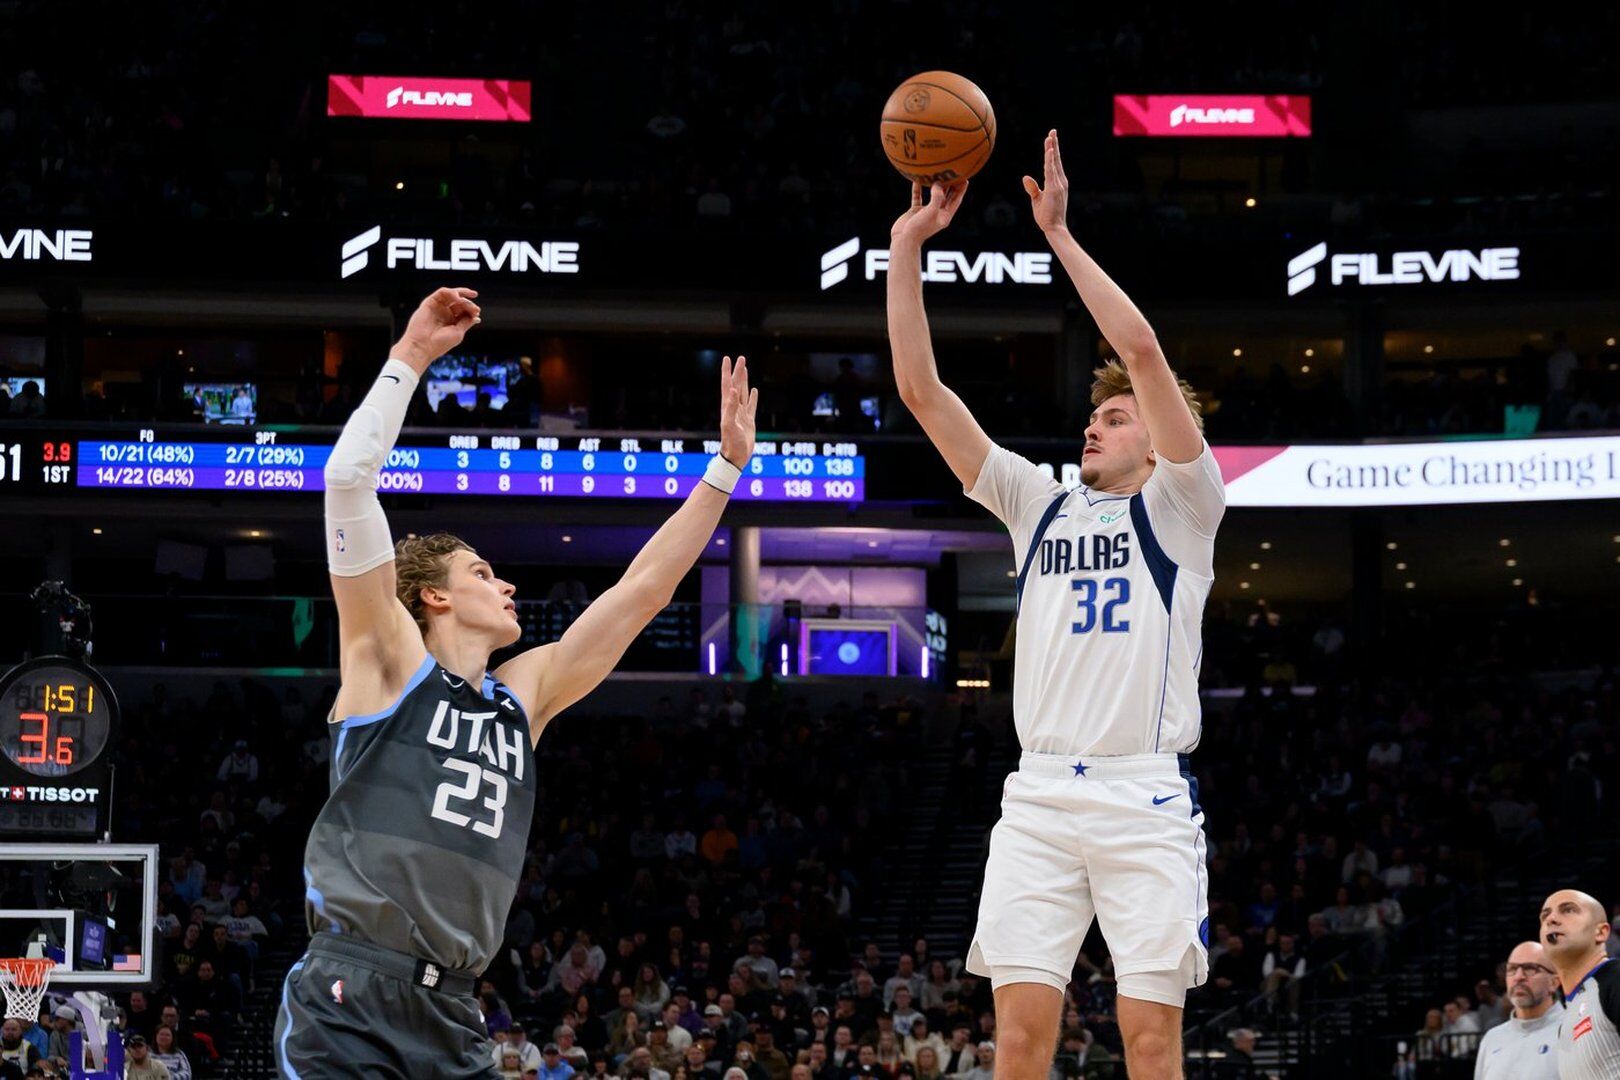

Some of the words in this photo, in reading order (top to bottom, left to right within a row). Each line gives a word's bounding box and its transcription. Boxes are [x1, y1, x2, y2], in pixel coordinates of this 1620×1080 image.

[402, 91, 472, 106] FILEVINE
[1185, 108, 1255, 123] FILEVINE
[387, 238, 579, 273] FILEVINE
[865, 249, 1052, 284] FEVINE
[1331, 247, 1520, 285] FILEVINE
[43, 443, 71, 462] 3.9
[256, 432, 276, 445] 3PT
[579, 438, 600, 452] AST
[620, 439, 641, 452] STL
[661, 440, 684, 453] BLK
[43, 466, 70, 483] 1ST
[100, 445, 144, 462] 10/21
[148, 445, 194, 464] (48%)
[226, 447, 255, 464] 2/7
[258, 447, 304, 466] (29%)
[457, 451, 469, 468] 3
[499, 452, 511, 469] 5
[540, 453, 553, 470] 8
[582, 453, 595, 471] 6
[624, 454, 637, 472] 0
[665, 455, 678, 472] 0
[751, 457, 763, 474] 5
[783, 458, 814, 475] 100
[825, 458, 854, 475] 138
[1307, 458, 1411, 490] Game
[1422, 451, 1595, 490] Changing
[96, 467, 143, 484] 14/22
[148, 468, 194, 486] (64%)
[225, 470, 255, 487] 2/8
[258, 470, 304, 488] (25%)
[457, 473, 469, 491] 3
[499, 474, 510, 491] 8
[539, 475, 553, 492] 11
[582, 476, 595, 493] 9
[624, 477, 636, 494] 3
[665, 478, 678, 495] 0
[751, 479, 763, 496] 6
[783, 480, 813, 498] 138
[824, 480, 855, 498] 100
[1041, 532, 1130, 576] DALAS
[1071, 577, 1131, 634] 32
[44, 685, 94, 714] 1:51
[17, 712, 74, 764] 3.6
[426, 700, 524, 781] UTAH
[27, 786, 99, 803] TISSOT
[431, 757, 508, 839] 23
